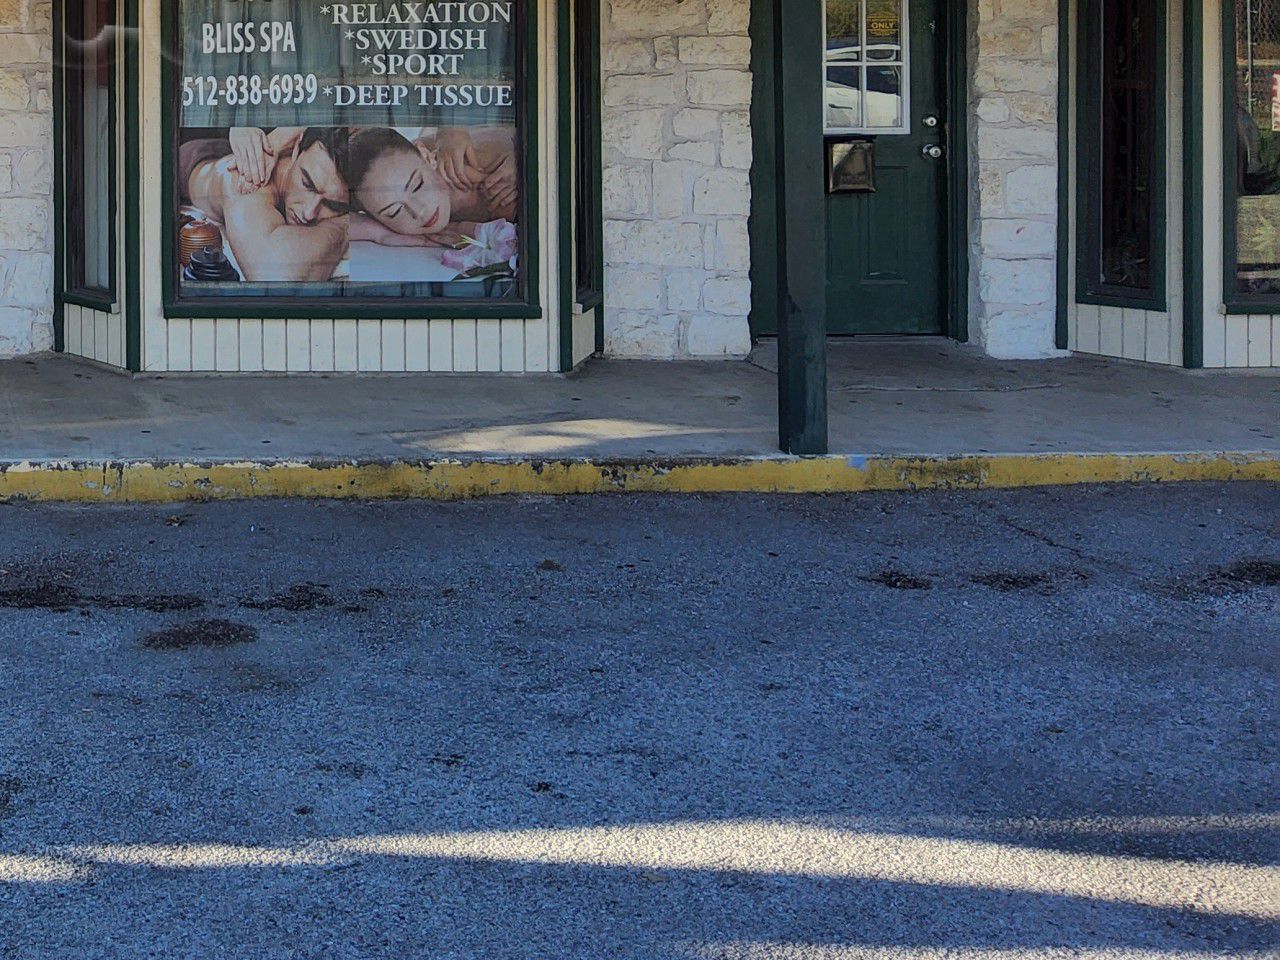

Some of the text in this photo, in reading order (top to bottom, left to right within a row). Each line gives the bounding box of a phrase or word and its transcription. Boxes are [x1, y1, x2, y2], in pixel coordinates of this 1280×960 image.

[202, 21, 296, 54] BLISS SPA
[871, 21, 895, 29] ONLY
[182, 73, 318, 107] 512-838-6939
[415, 84, 513, 107] TISSUE
